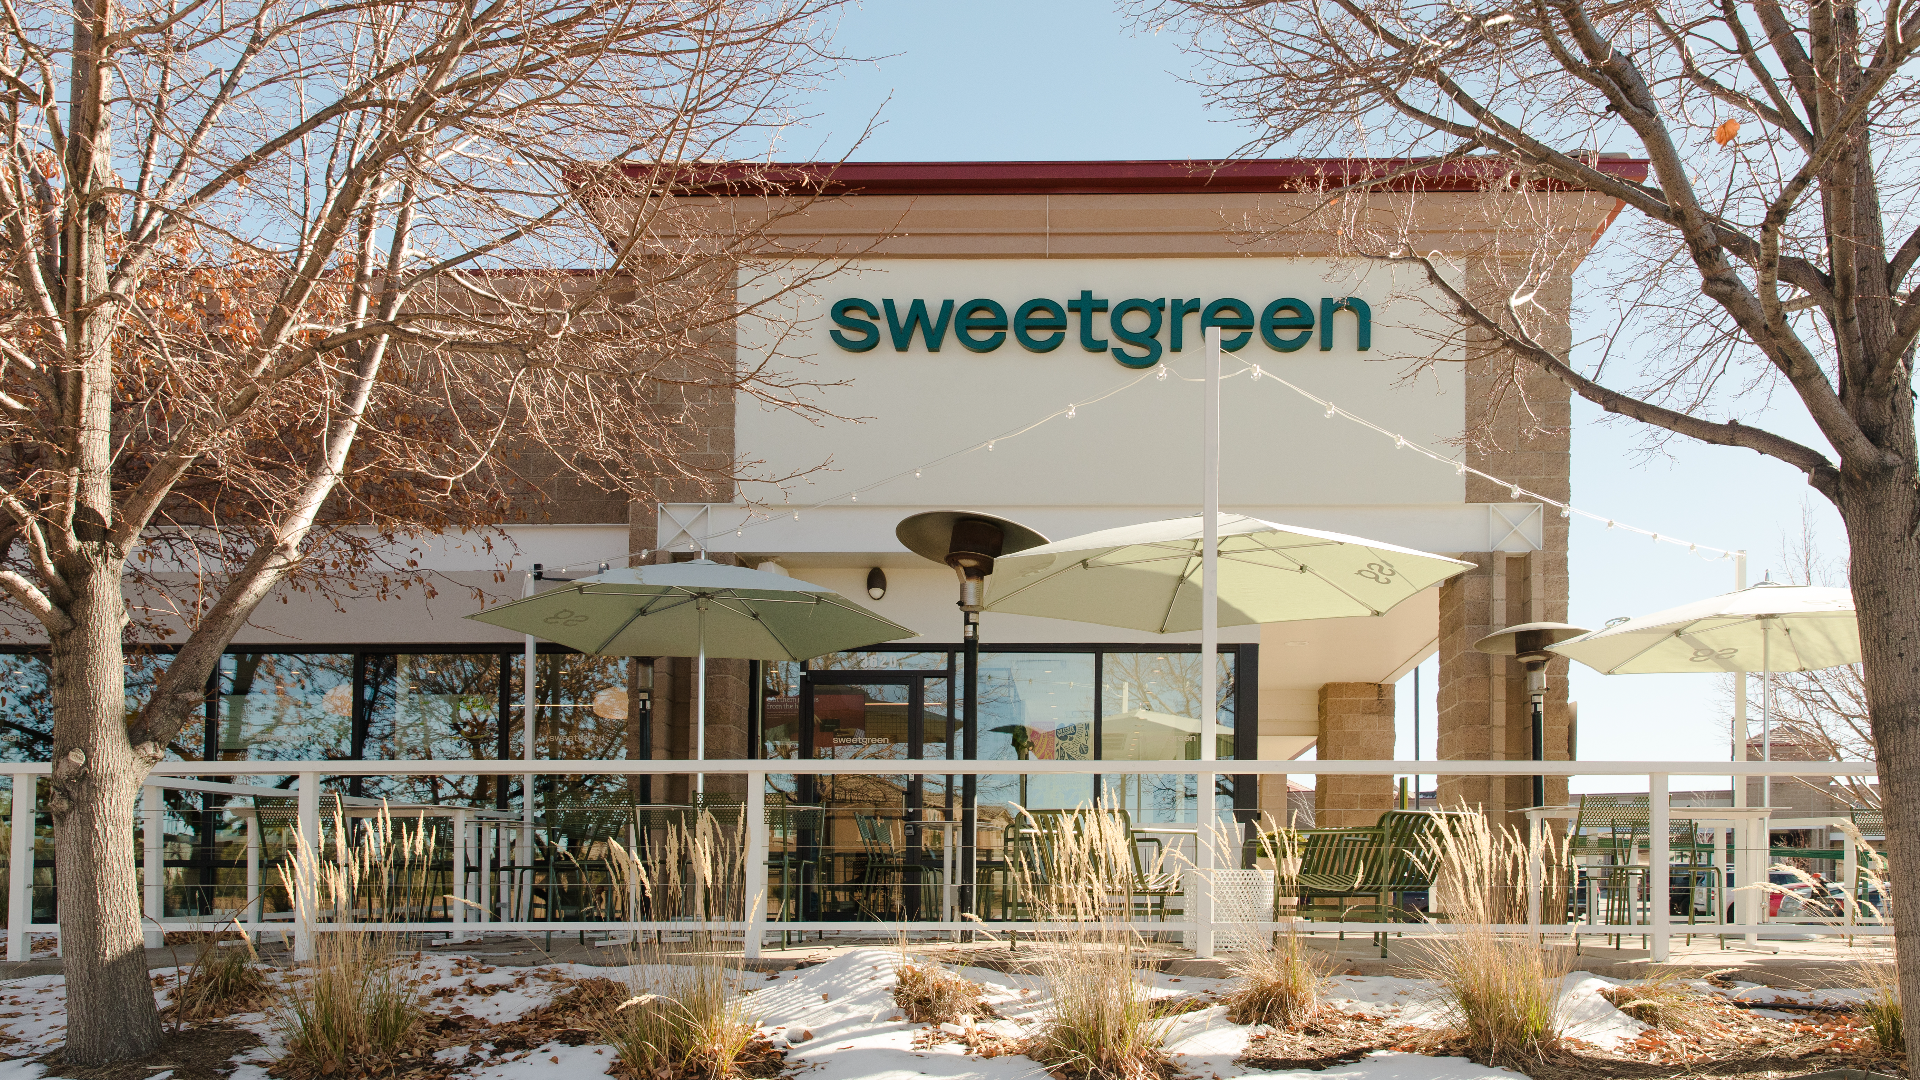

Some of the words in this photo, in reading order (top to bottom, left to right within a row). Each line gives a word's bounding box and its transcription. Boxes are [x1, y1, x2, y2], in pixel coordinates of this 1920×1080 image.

[829, 289, 1373, 369] sweetgreen
[860, 655, 897, 668] 3620
[832, 736, 889, 746] sweetgreen
